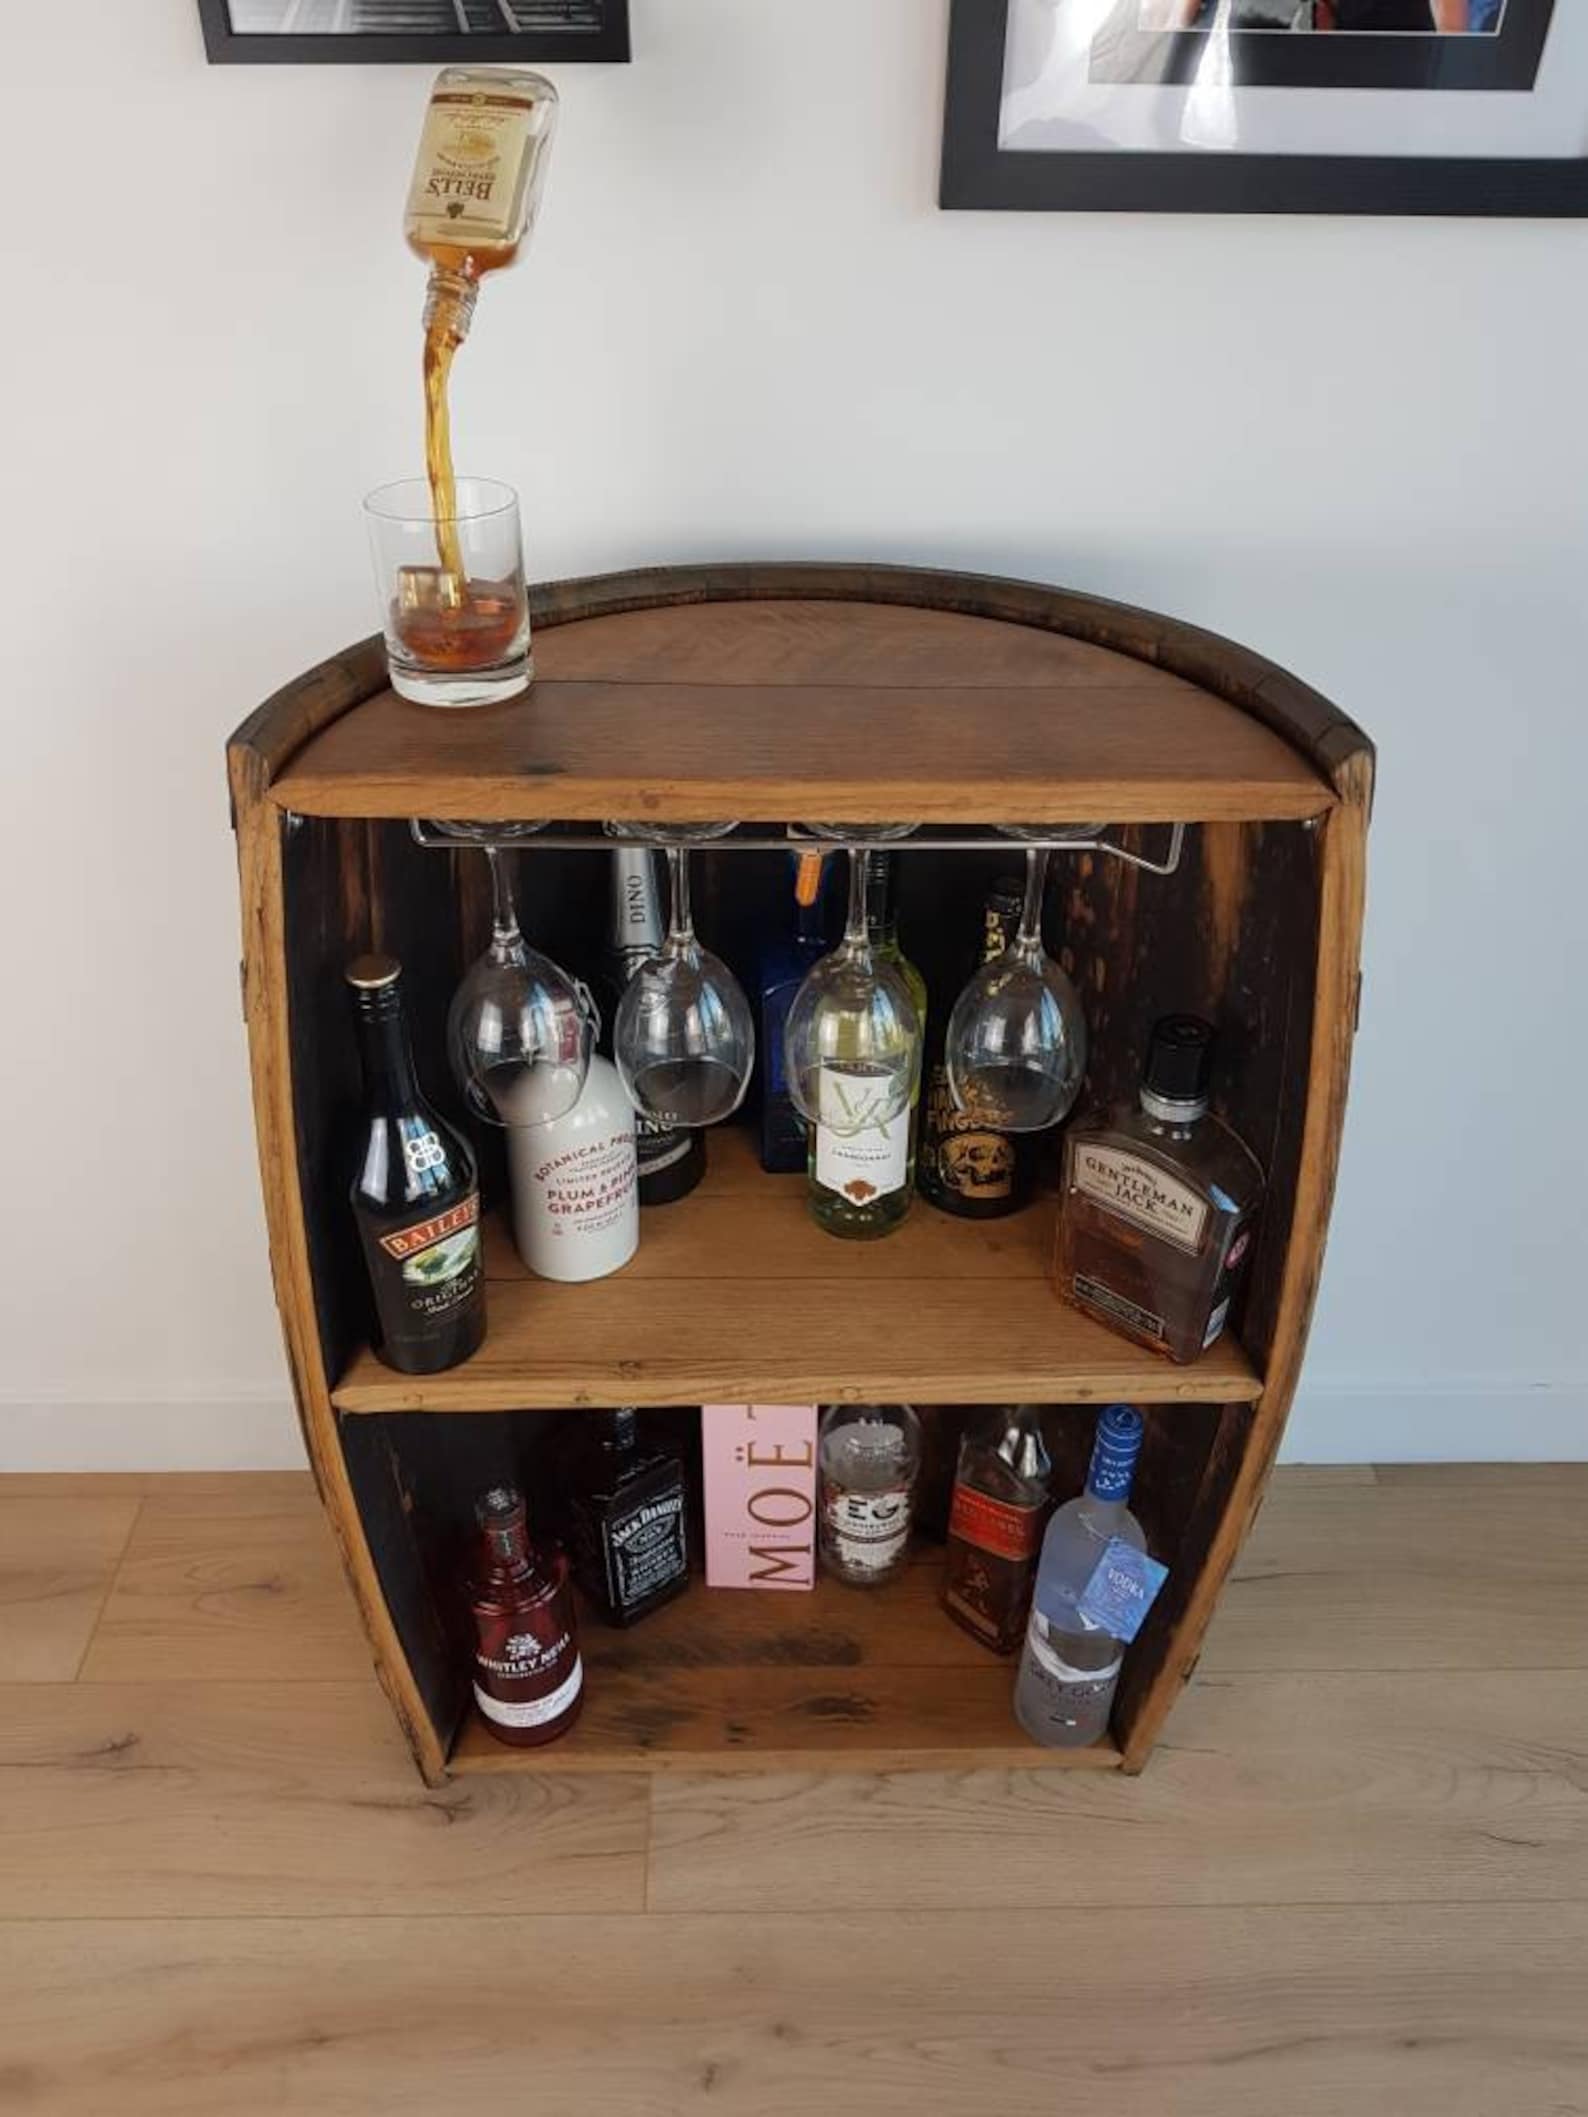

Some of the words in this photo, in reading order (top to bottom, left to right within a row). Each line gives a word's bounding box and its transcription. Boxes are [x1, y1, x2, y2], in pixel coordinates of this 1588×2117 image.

[626, 874, 646, 924] DINO
[547, 1188, 594, 1201] PLUM
[1085, 1155, 1195, 1217] GENTLEMAN
[1114, 1182, 1158, 1214] JACK
